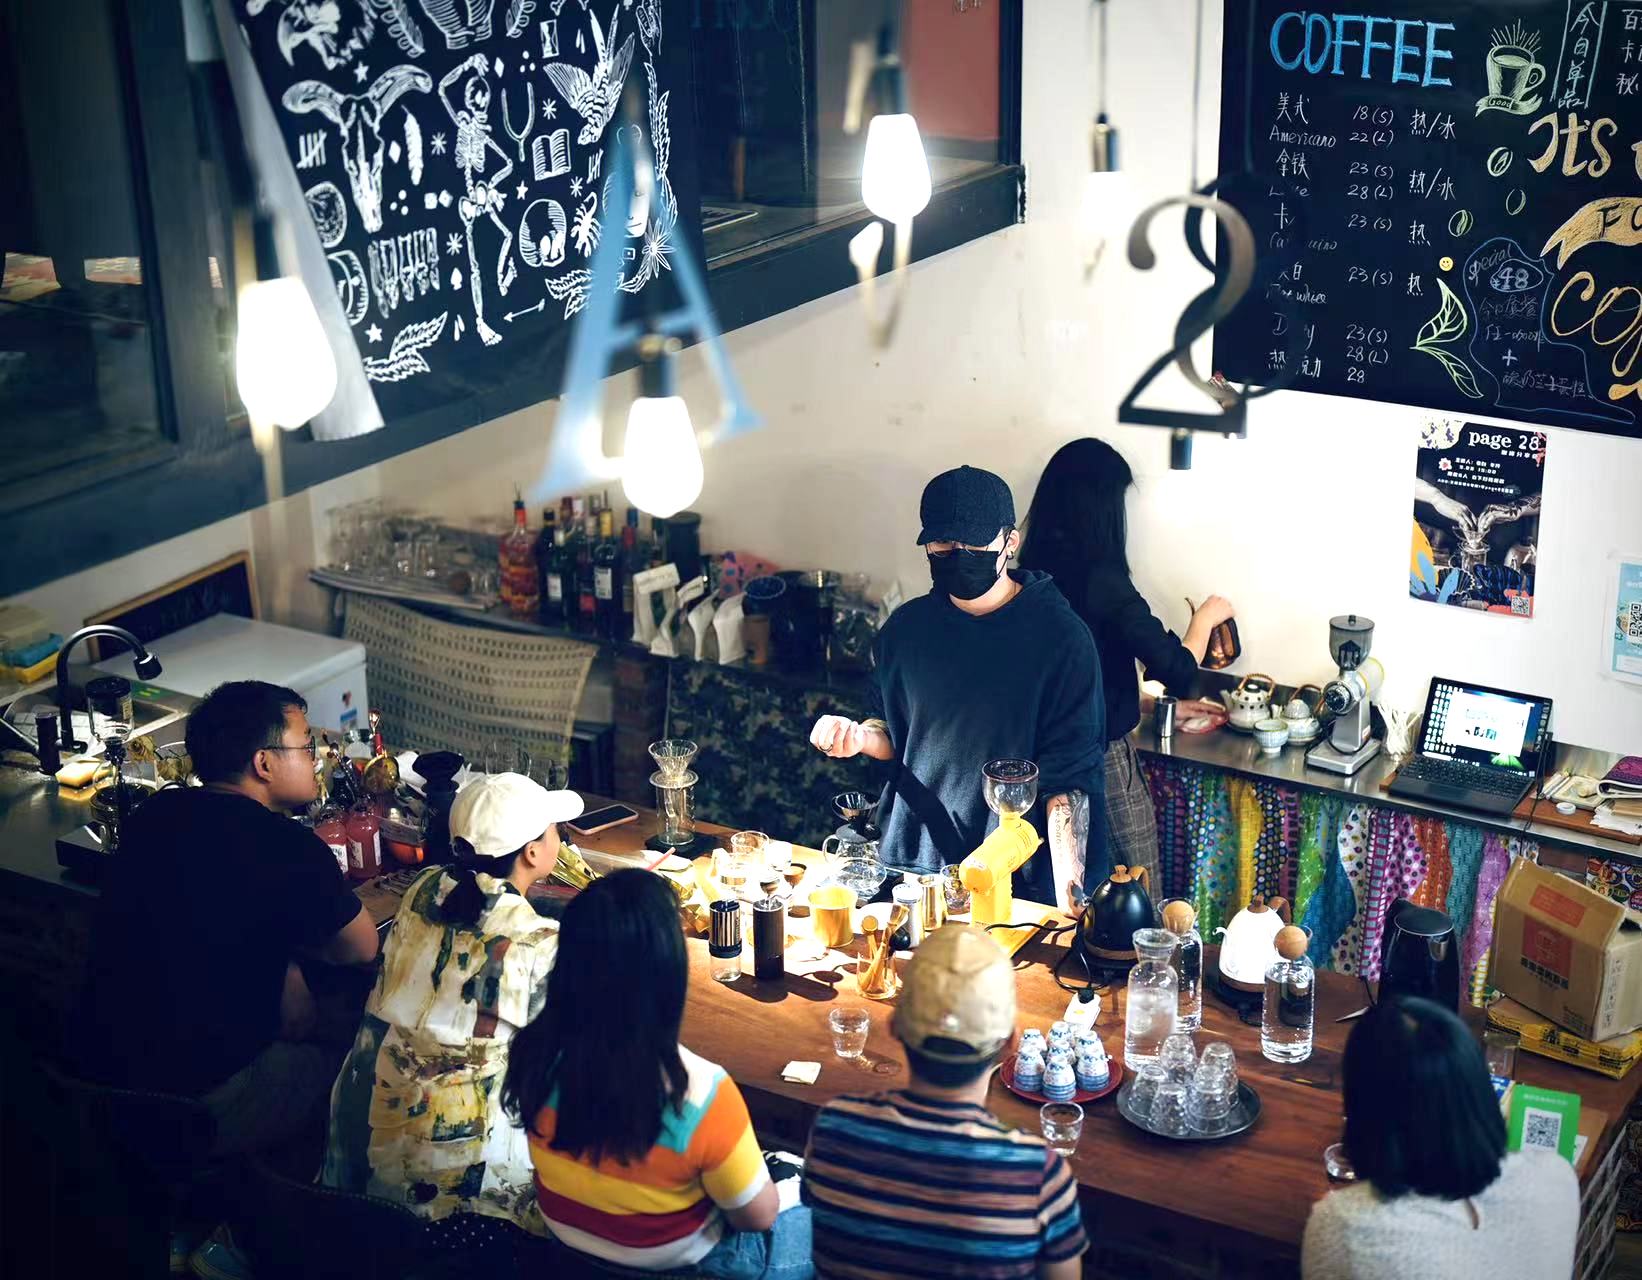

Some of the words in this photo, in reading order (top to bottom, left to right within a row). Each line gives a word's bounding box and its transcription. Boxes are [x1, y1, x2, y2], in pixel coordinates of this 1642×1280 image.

[1270, 12, 1456, 87] COFFEE
[1276, 91, 1310, 125] 美式
[1269, 124, 1337, 149] Americano
[1276, 148, 1311, 181] 拿铁
[1347, 366, 1366, 384] 28
[1467, 431, 1513, 450] page
[1518, 434, 1540, 451] 28
